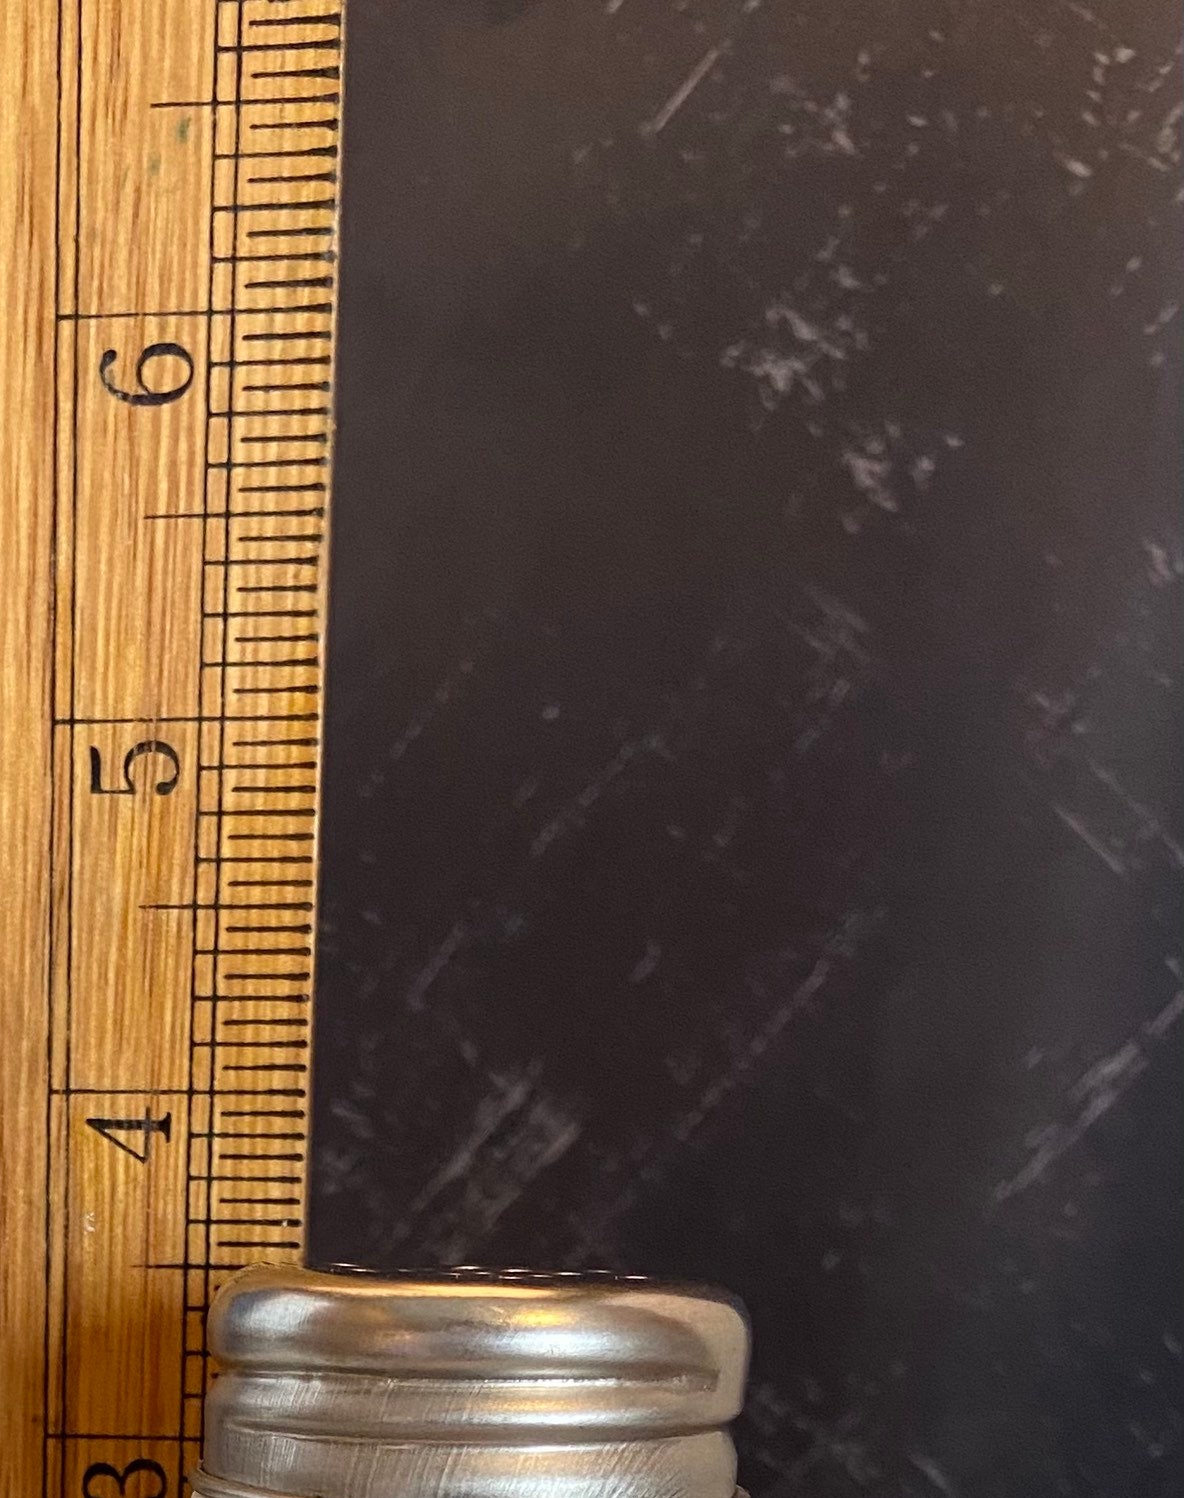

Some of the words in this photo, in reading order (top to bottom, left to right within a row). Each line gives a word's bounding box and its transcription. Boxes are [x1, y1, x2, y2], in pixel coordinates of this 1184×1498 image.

[100, 341, 194, 406] 6
[90, 739, 180, 796] 5
[85, 1106, 172, 1164] 4
